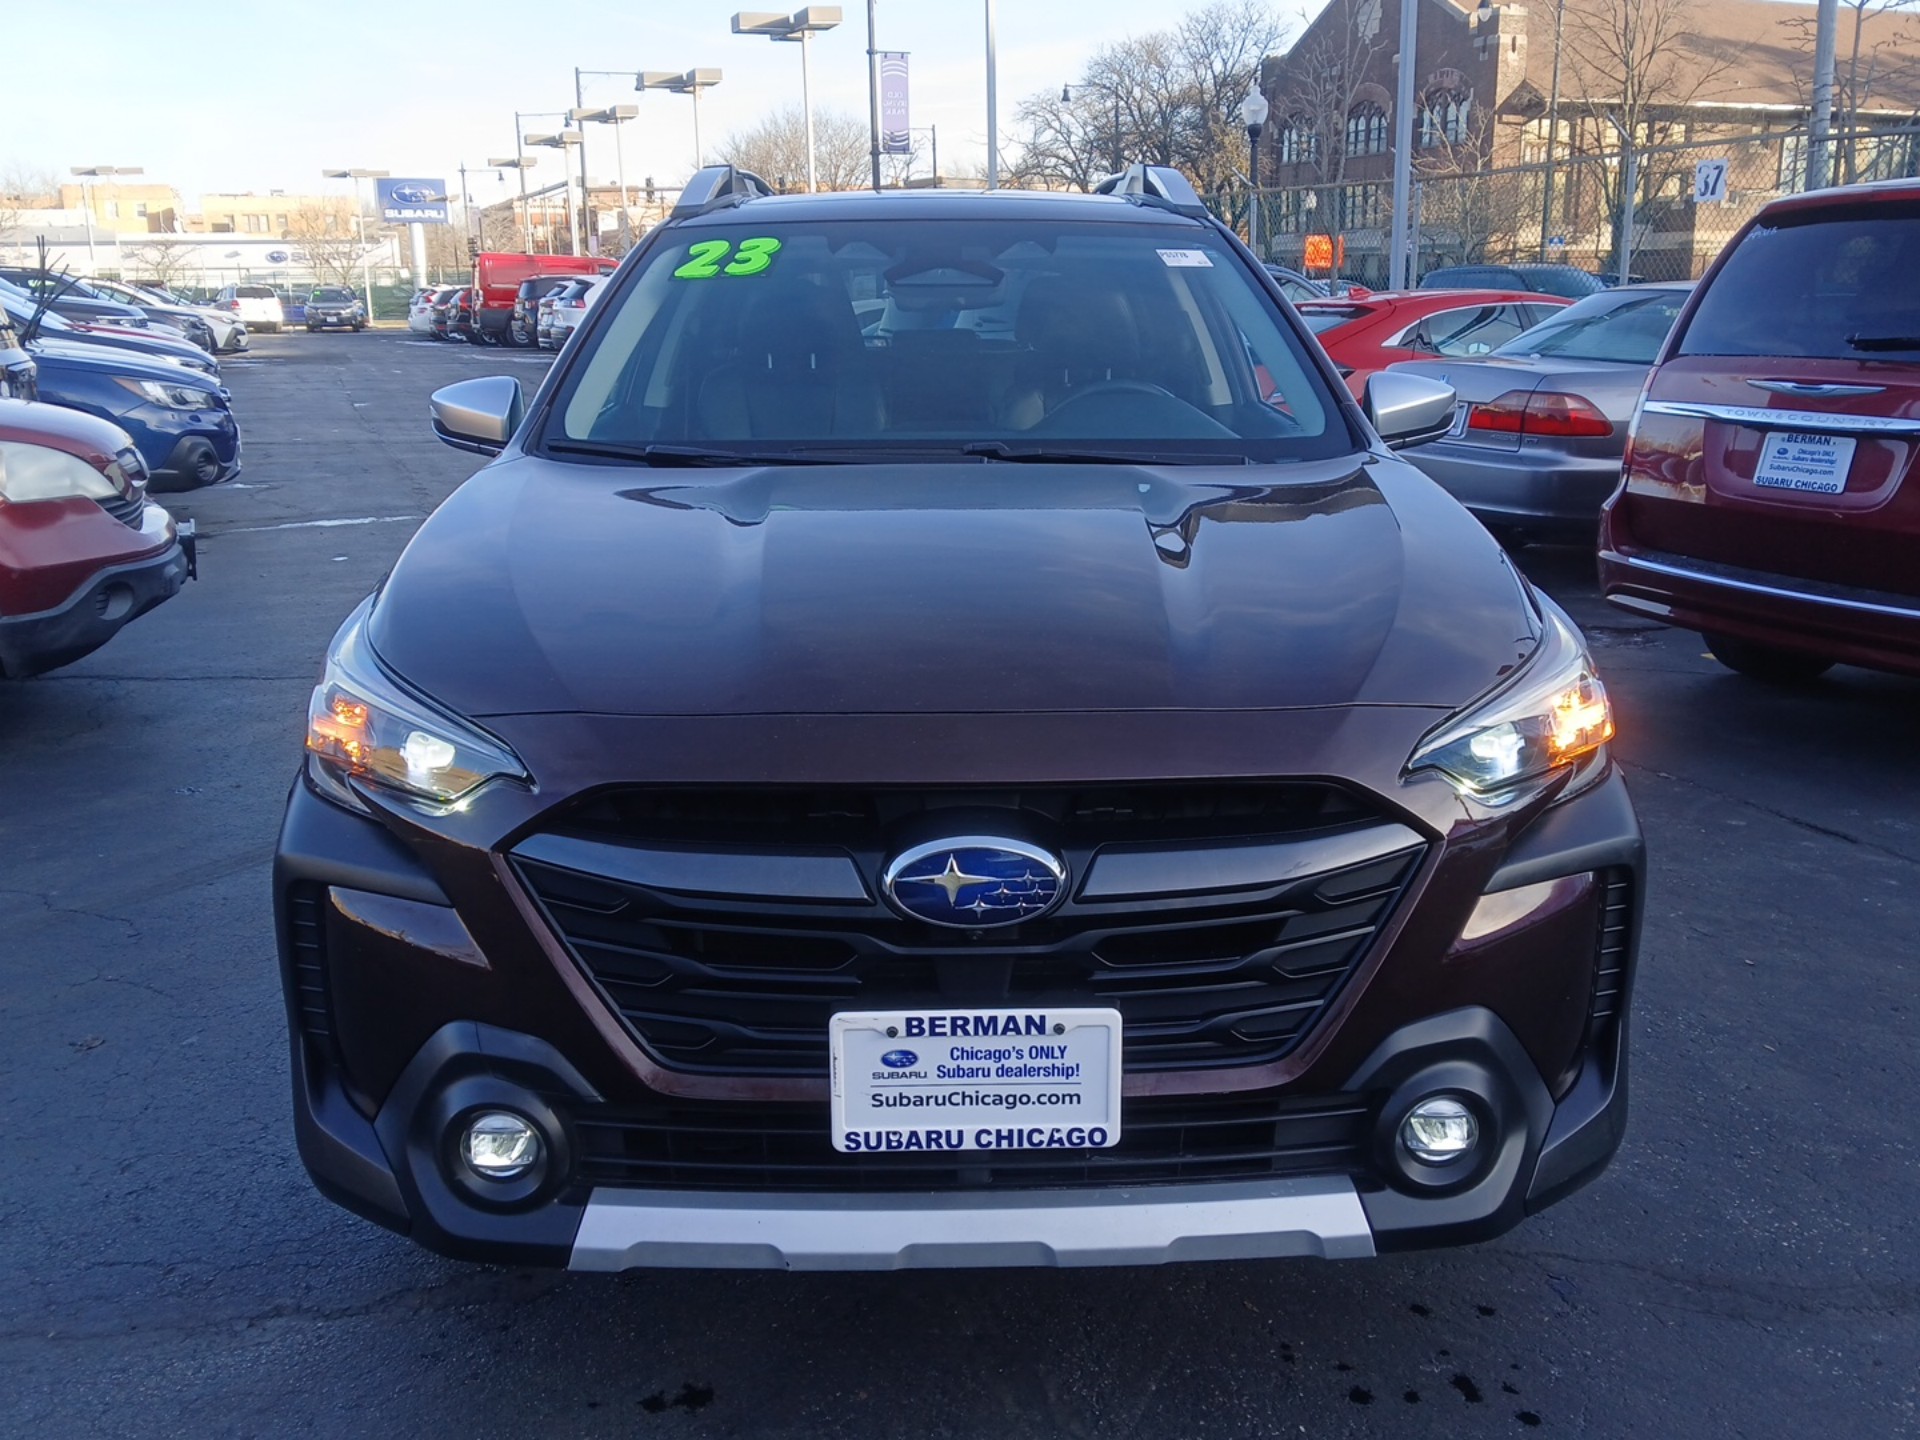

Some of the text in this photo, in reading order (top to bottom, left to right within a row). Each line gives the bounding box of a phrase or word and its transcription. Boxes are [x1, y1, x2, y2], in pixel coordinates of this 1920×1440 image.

[1698, 164, 1724, 197] 37
[384, 208, 445, 218] SUBARU
[674, 237, 782, 279] 23
[1725, 408, 1771, 418] TOWN
[1787, 412, 1893, 427] COUNTRY
[1787, 433, 1832, 446] BERMAN
[1769, 463, 1834, 476] SubaruChicago.com
[1755, 475, 1838, 492] SUBARU CHICAGO
[905, 1014, 1047, 1037] BERMAN
[950, 1045, 1068, 1063] Chicago's ONLY
[872, 1071, 928, 1080] SUBARU
[936, 1063, 1080, 1080] Subaru dealership!
[871, 1090, 1082, 1109] SubaruChicago.com
[844, 1127, 1108, 1151] SUBARU CHICAGO
